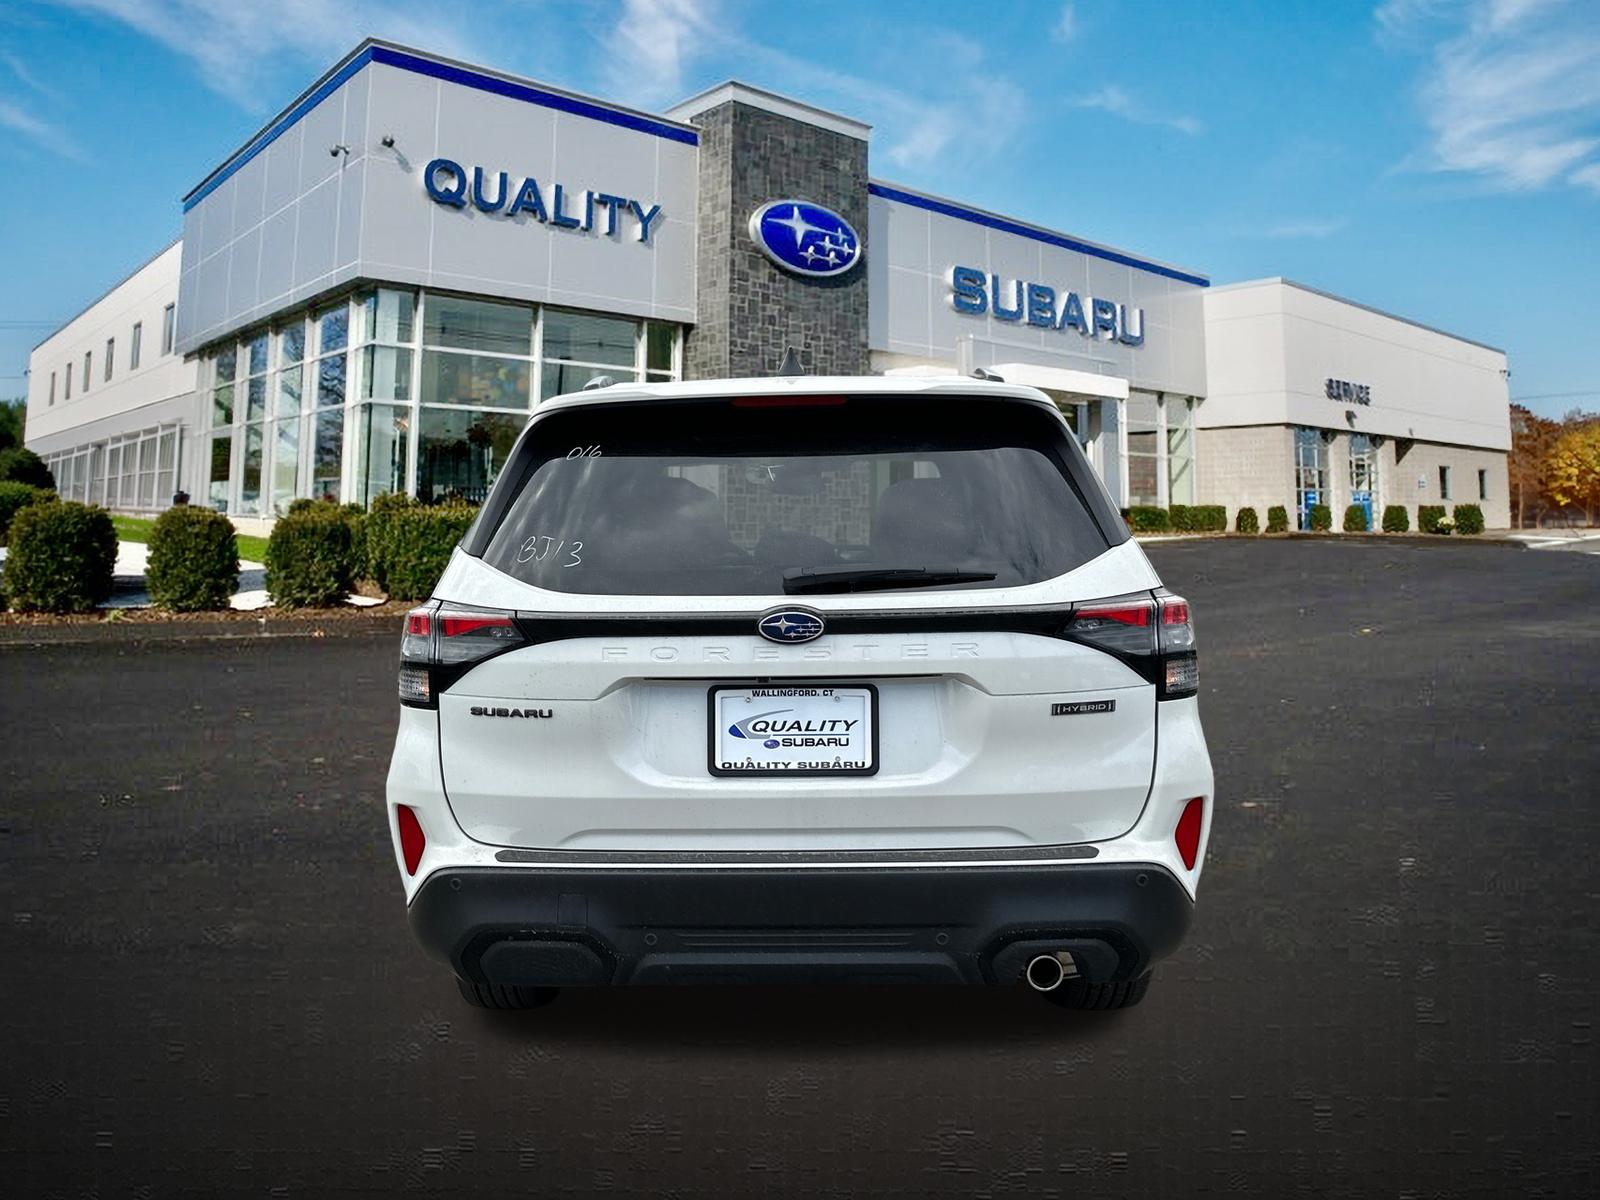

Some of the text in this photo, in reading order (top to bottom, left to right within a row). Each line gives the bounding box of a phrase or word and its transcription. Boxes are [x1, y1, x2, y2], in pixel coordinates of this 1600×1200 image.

[423, 157, 662, 243] QUALITY
[949, 265, 1145, 347] SUBARU
[601, 642, 980, 662] FORESTER
[822, 689, 835, 697] CT
[470, 706, 553, 718] SUBARU
[1063, 704, 1106, 712] HYBRID
[751, 720, 859, 733] QUALITY
[781, 737, 850, 747] SUBARU
[721, 761, 866, 769] QUALITY SUBARU
